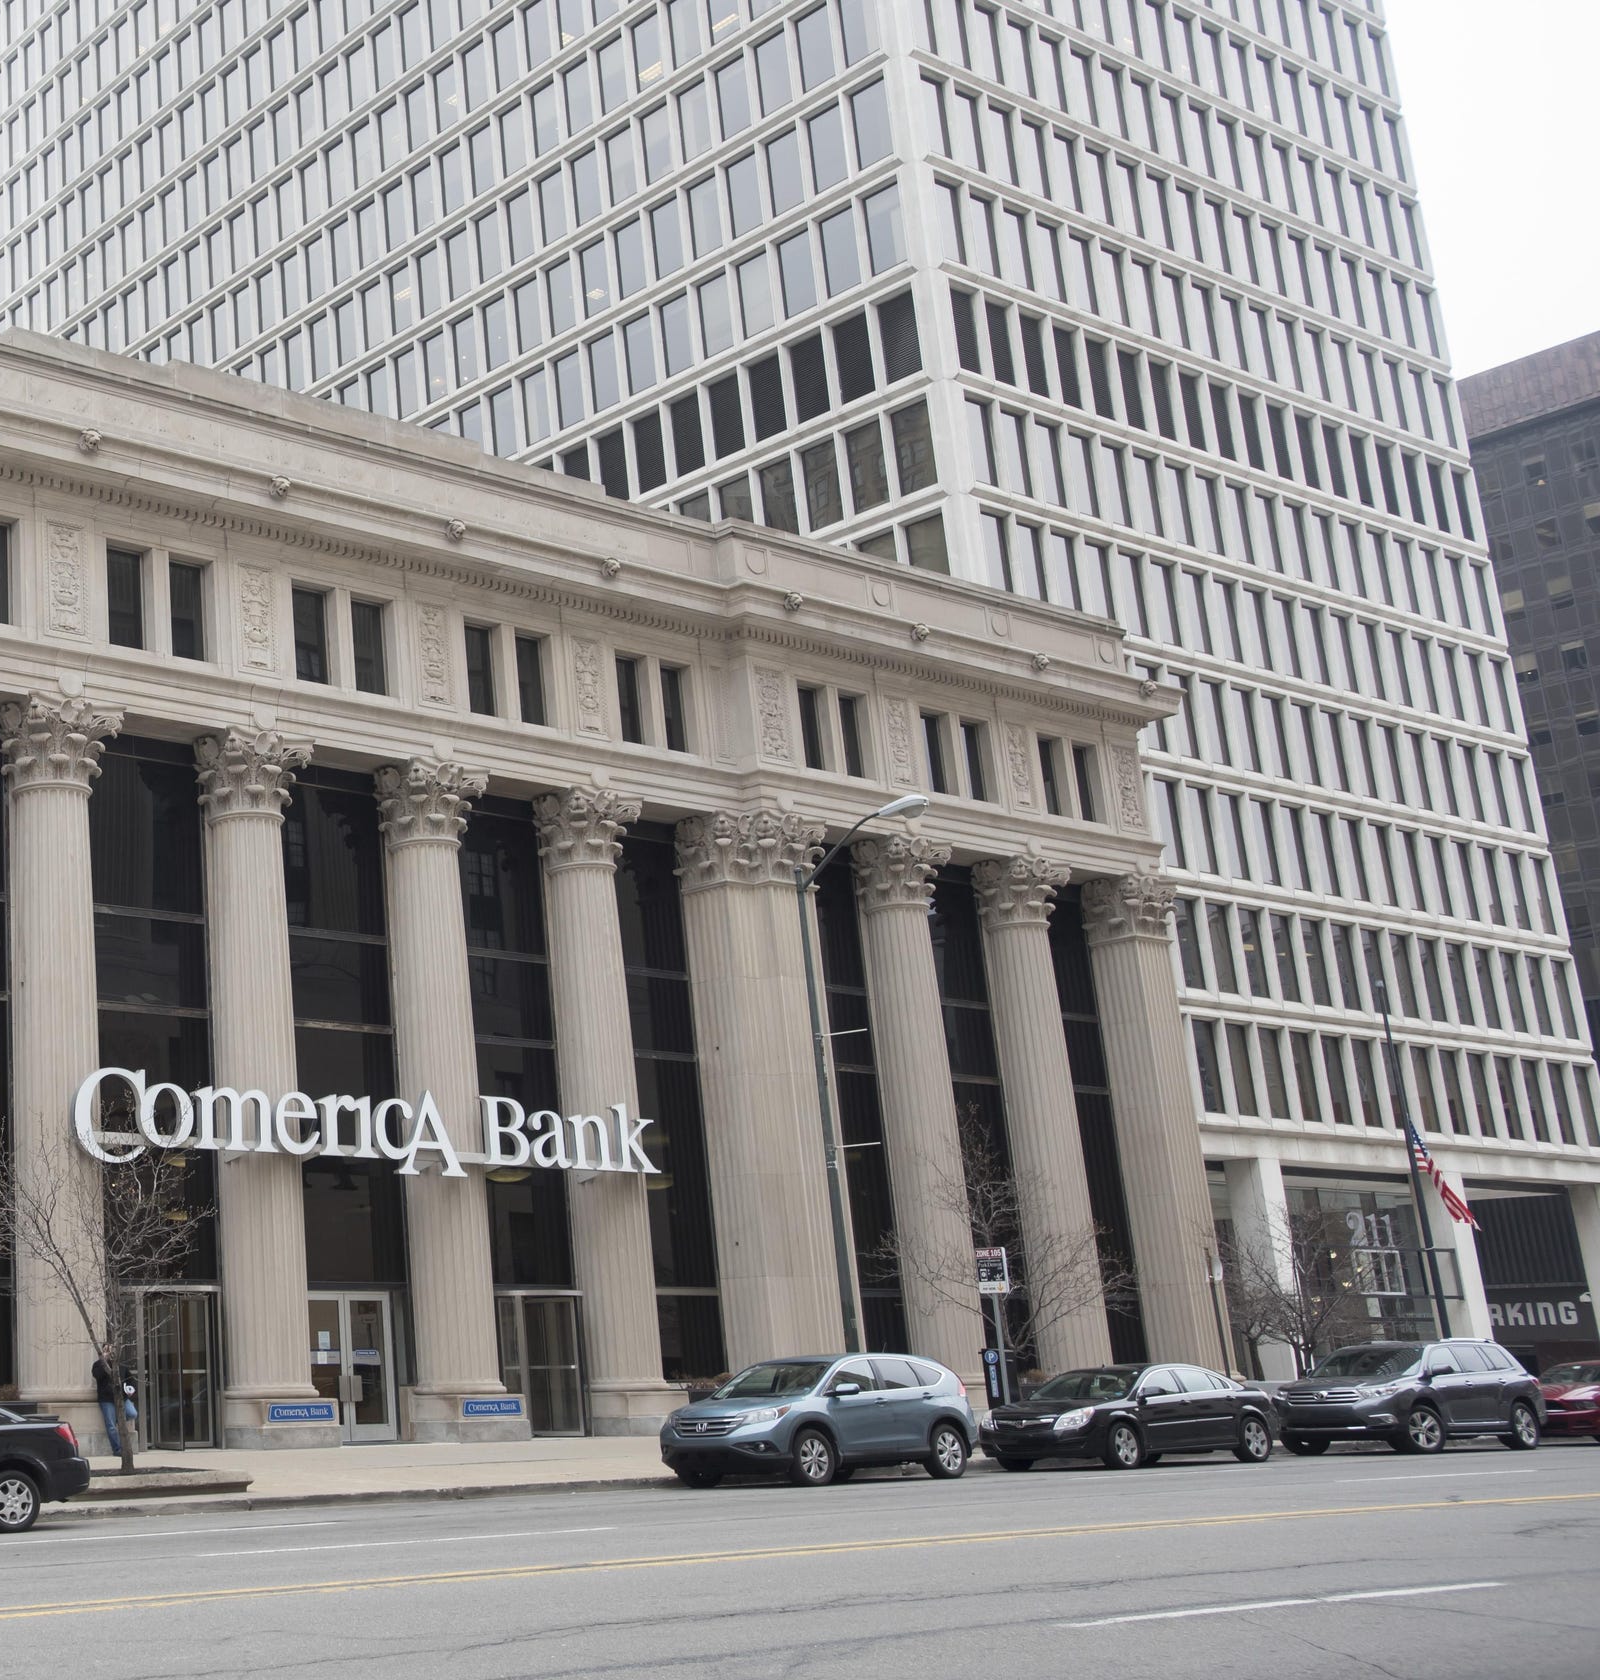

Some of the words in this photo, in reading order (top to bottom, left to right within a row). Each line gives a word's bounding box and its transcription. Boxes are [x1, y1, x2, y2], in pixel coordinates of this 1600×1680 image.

[479, 1094, 662, 1175] Bank
[1345, 1211, 1396, 1248] 211
[976, 1250, 990, 1258] ZONE
[990, 1249, 1002, 1257] 105
[500, 1402, 517, 1411] Bank
[310, 1407, 329, 1416] Bank
